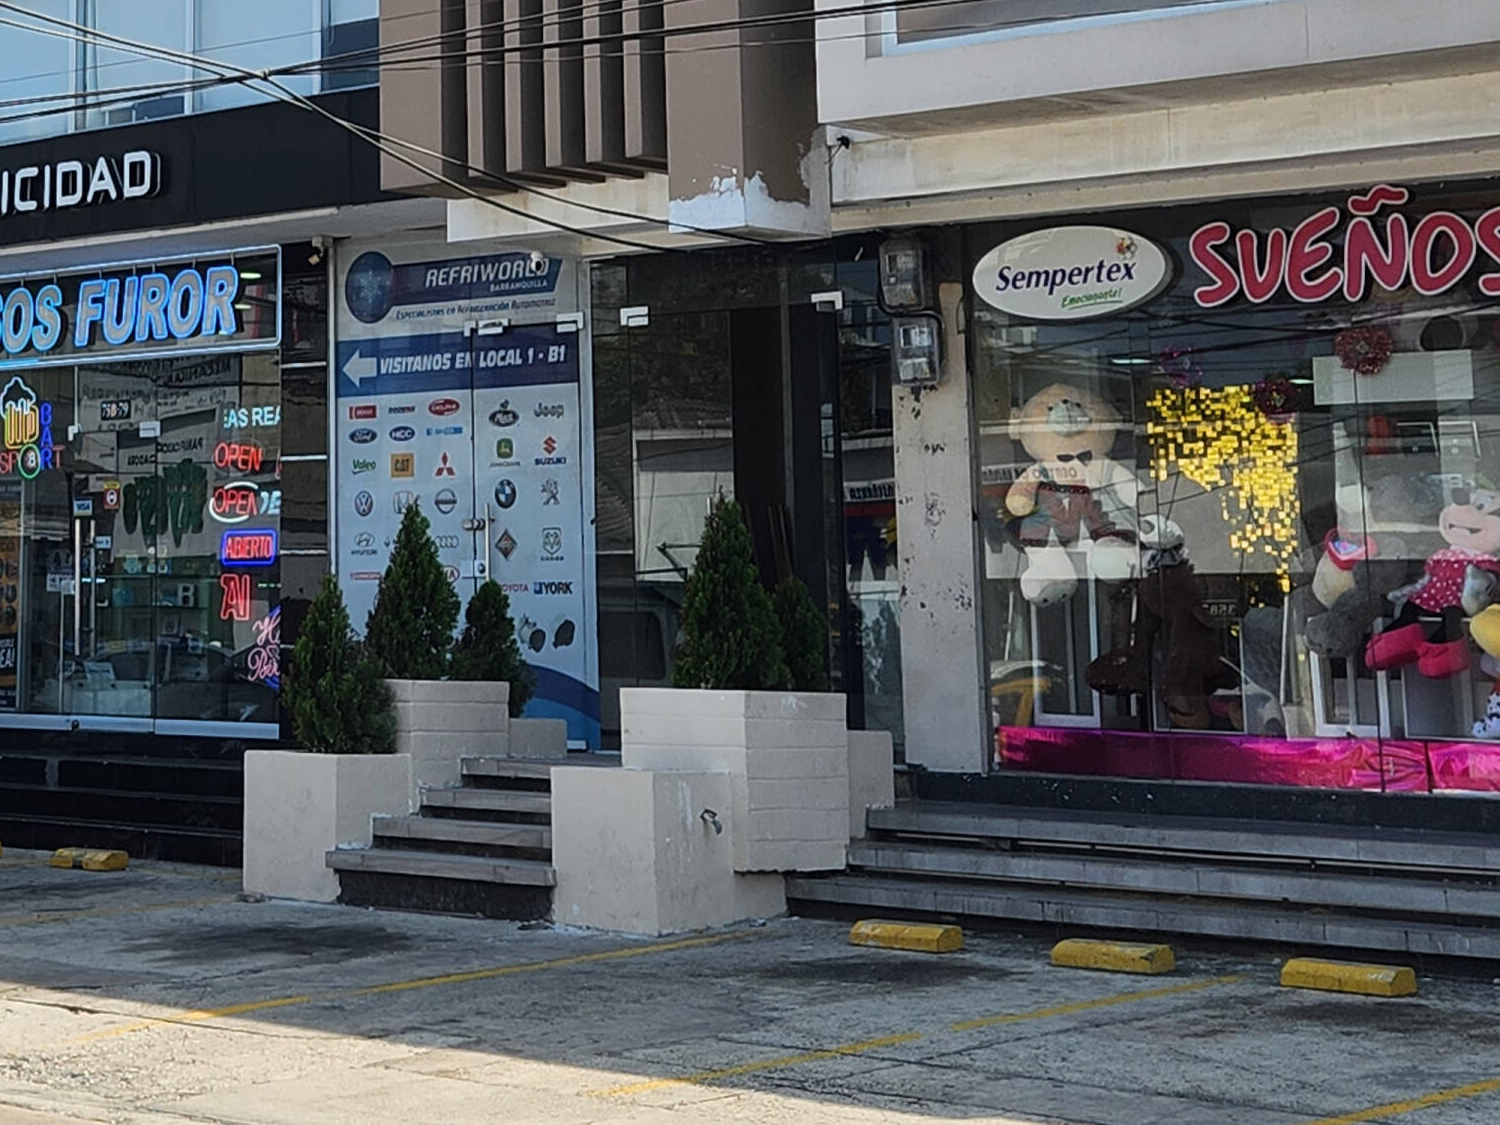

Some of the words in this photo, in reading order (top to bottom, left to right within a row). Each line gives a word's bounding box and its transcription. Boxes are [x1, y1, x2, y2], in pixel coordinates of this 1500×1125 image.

[995, 259, 1138, 296] Sempertex
[74, 264, 239, 348] FUROR
[380, 350, 451, 376] VISITANOS
[479, 347, 522, 368] LOCAL
[548, 344, 566, 363] B1
[214, 441, 262, 471] OPEN
[213, 488, 258, 515] OPEN
[226, 536, 273, 559] ABIERTO
[542, 580, 572, 595] YORK
